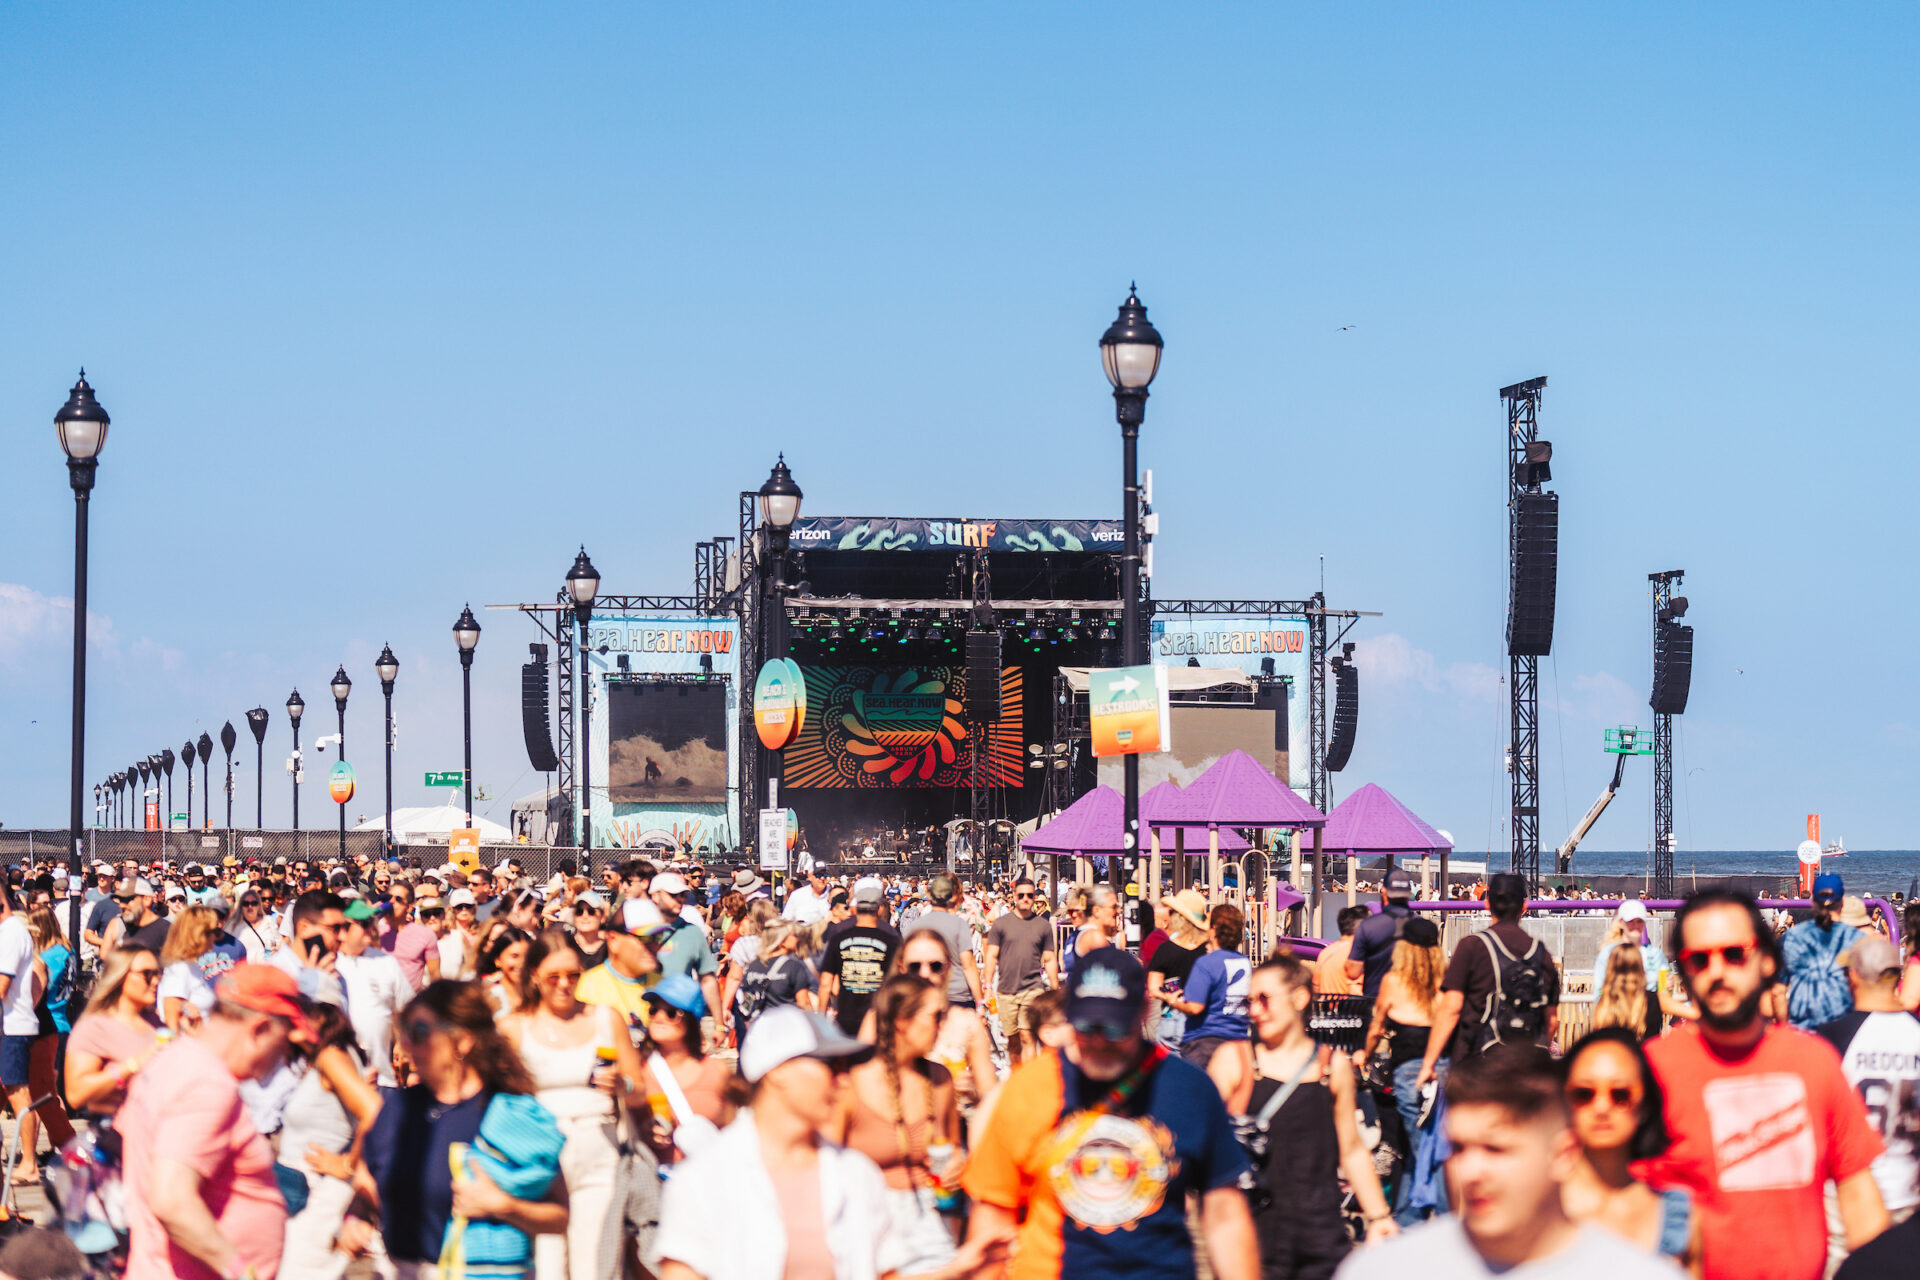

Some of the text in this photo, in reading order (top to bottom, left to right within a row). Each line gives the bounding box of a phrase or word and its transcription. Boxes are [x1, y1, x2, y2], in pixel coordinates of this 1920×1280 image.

[788, 527, 831, 540] erizon
[929, 521, 997, 548] SURF
[1091, 528, 1125, 541] veriz
[429, 774, 444, 785] 7th
[1319, 1018, 1356, 1029] RECYCLE
